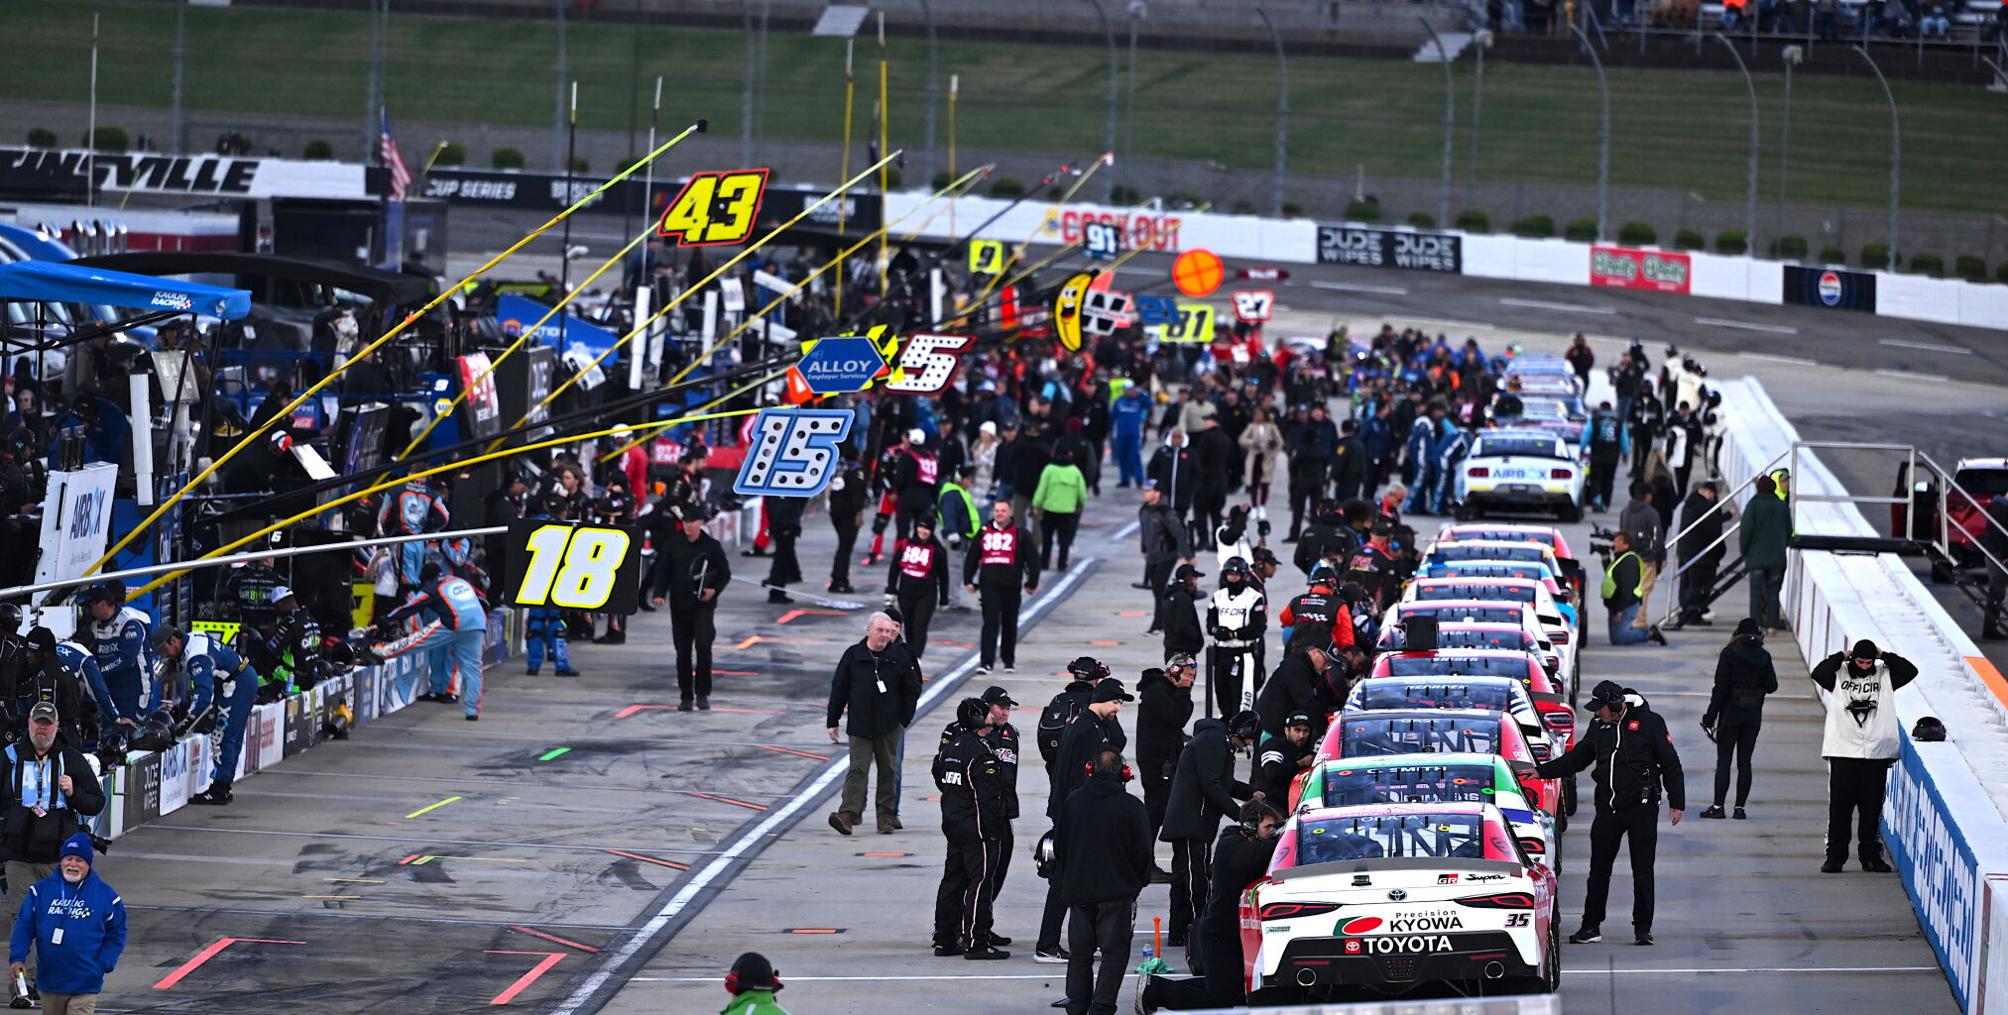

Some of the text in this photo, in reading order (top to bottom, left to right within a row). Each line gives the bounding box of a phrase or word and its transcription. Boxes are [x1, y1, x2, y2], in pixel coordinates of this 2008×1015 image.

[459, 181, 518, 200] SERIES
[664, 174, 763, 243] 43
[1087, 224, 1117, 253] 91
[1134, 216, 1180, 250] OUT
[1321, 229, 1455, 257] DUDE DUDE
[977, 245, 996, 267] 9
[1321, 248, 1455, 272] WIPES WIPES
[151, 297, 184, 308] RACING
[155, 291, 187, 300] KAULIG
[1237, 292, 1271, 319] 27
[807, 359, 873, 373] ALLOY
[885, 334, 971, 392] 5
[743, 415, 845, 490] 15
[983, 533, 1013, 551] 382
[515, 524, 631, 609] 18
[1841, 680, 1882, 693] OFFICIA
[1465, 873, 1506, 884] Supra
[48, 907, 83, 915] RACNG
[1395, 909, 1457, 919] Precision
[1505, 912, 1532, 928] 35
[1389, 916, 1464, 933] KYOWA
[1363, 935, 1453, 954] TOYOTA
